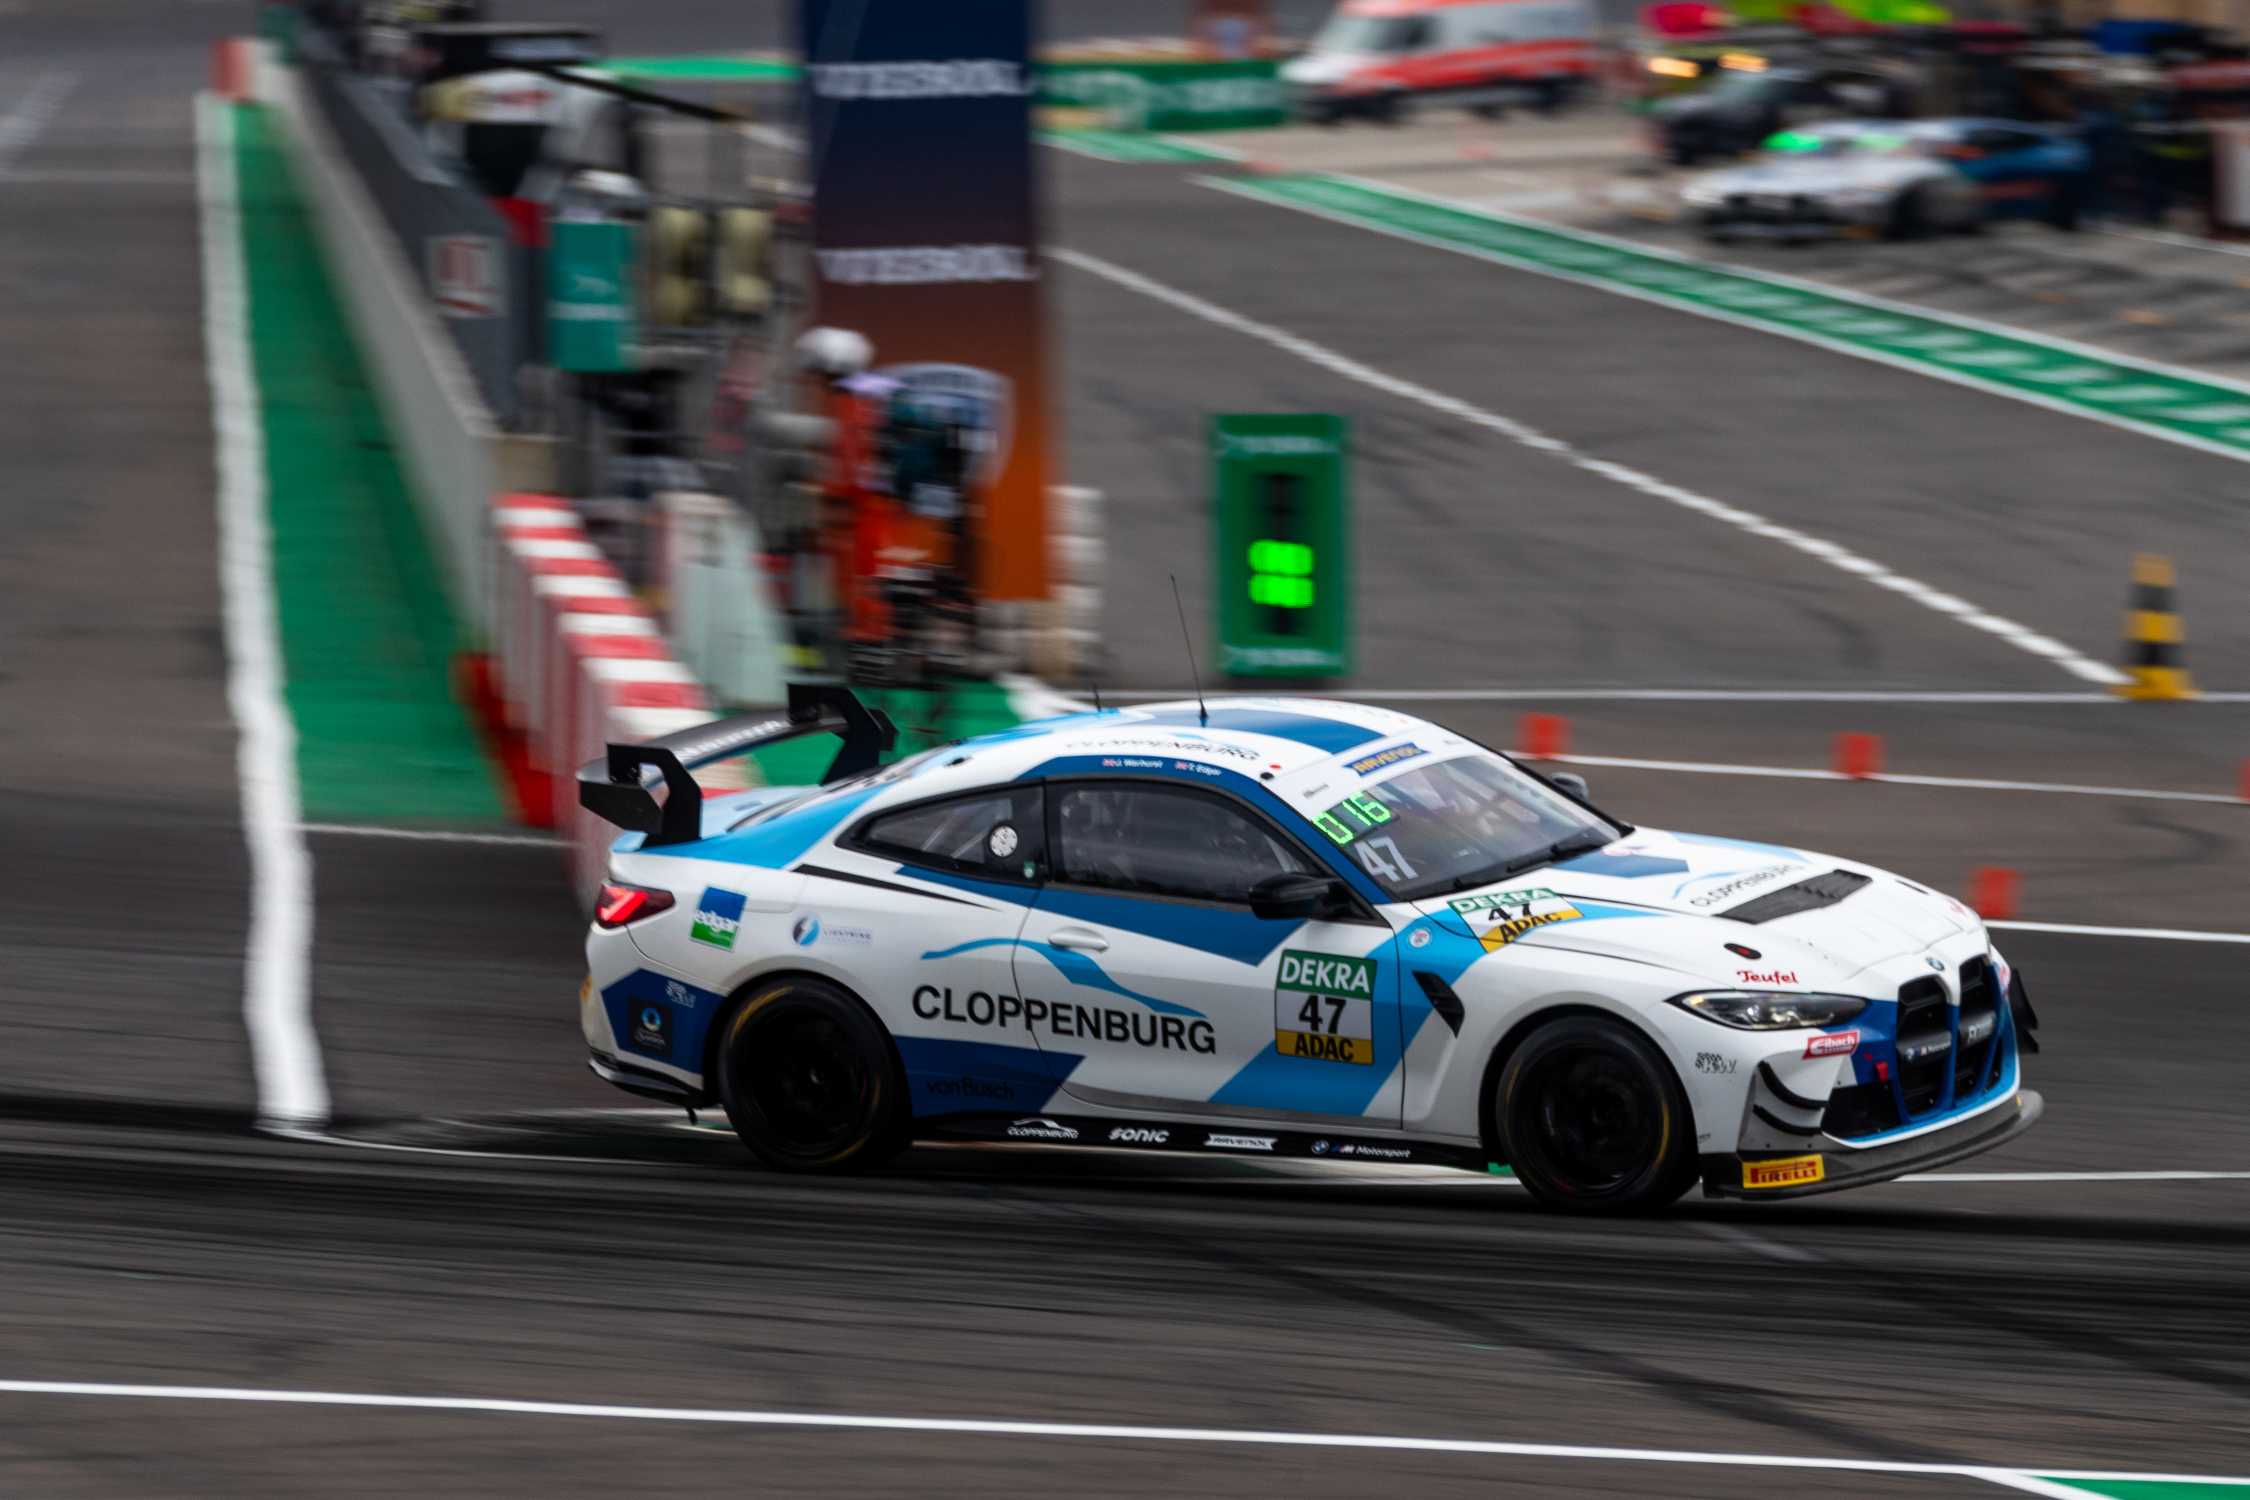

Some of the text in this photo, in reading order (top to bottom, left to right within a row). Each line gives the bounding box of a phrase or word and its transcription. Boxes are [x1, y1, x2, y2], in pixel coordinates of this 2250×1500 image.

[1353, 836, 1419, 882] 47
[1453, 889, 1553, 913] DEKRA
[1488, 902, 1533, 921] 47
[1499, 913, 1563, 944] ADAC
[1281, 956, 1370, 993] DEKRA
[1736, 970, 1799, 985] Teufel
[912, 984, 1217, 1055] CLOPPENBURG
[1298, 994, 1348, 1035] 47
[1295, 1032, 1355, 1062] ADAC
[1750, 1160, 1818, 1184] PIRELLI
